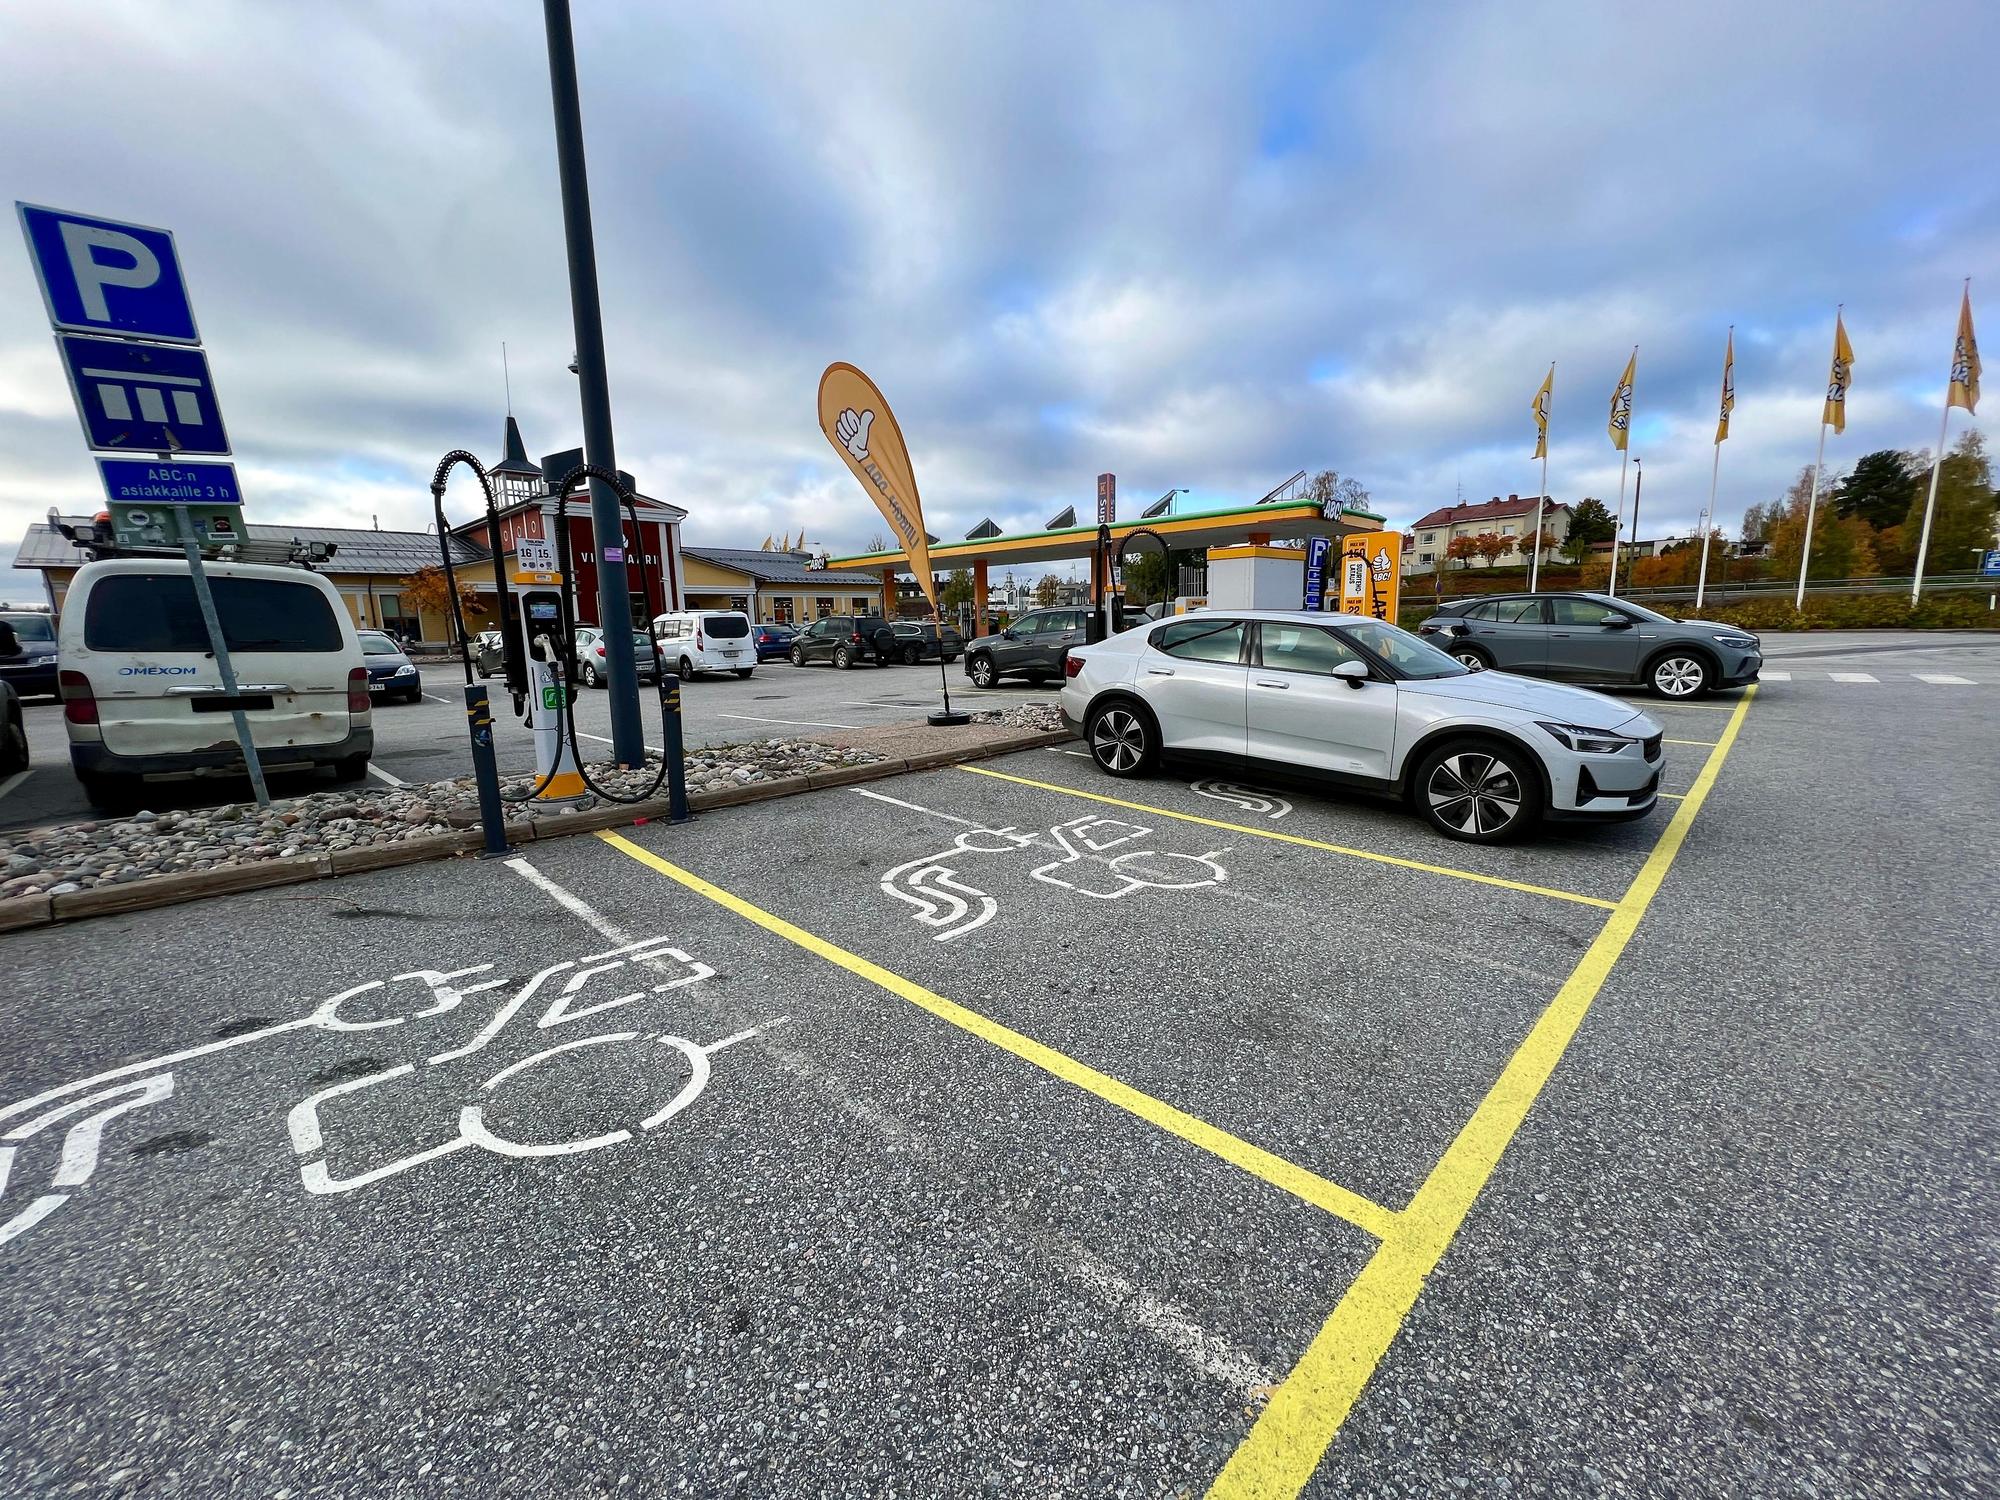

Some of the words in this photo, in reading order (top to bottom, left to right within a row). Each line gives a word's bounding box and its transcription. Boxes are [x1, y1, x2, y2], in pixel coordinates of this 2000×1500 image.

[58, 220, 160, 322] P
[148, 469, 197, 481] ABC:n
[121, 485, 201, 498] asiakkaille
[206, 486, 215, 498] 3
[219, 487, 229, 498] h
[1324, 501, 1343, 520] ABC!
[520, 548, 532, 558] 16
[1373, 571, 1392, 582] ABC!
[118, 666, 197, 676] OMEXOM
